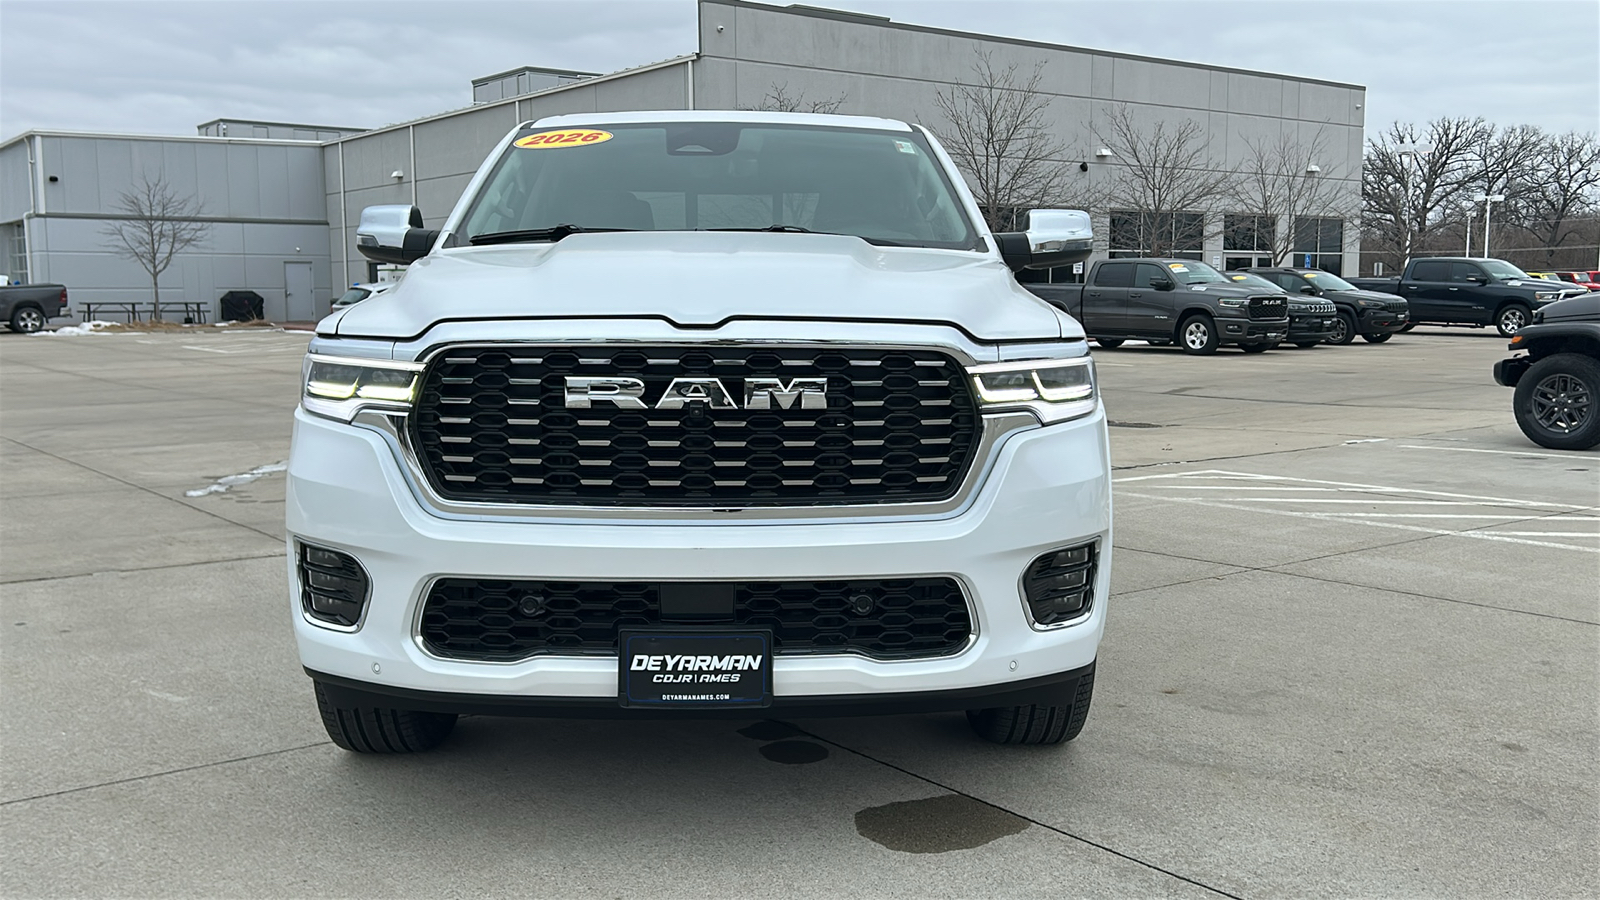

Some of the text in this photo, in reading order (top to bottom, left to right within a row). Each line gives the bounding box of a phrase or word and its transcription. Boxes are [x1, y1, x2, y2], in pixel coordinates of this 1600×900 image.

[523, 132, 603, 147] 2026
[563, 376, 828, 410] RAM
[630, 654, 762, 671] DEYARMAN
[699, 673, 741, 683] AMES
